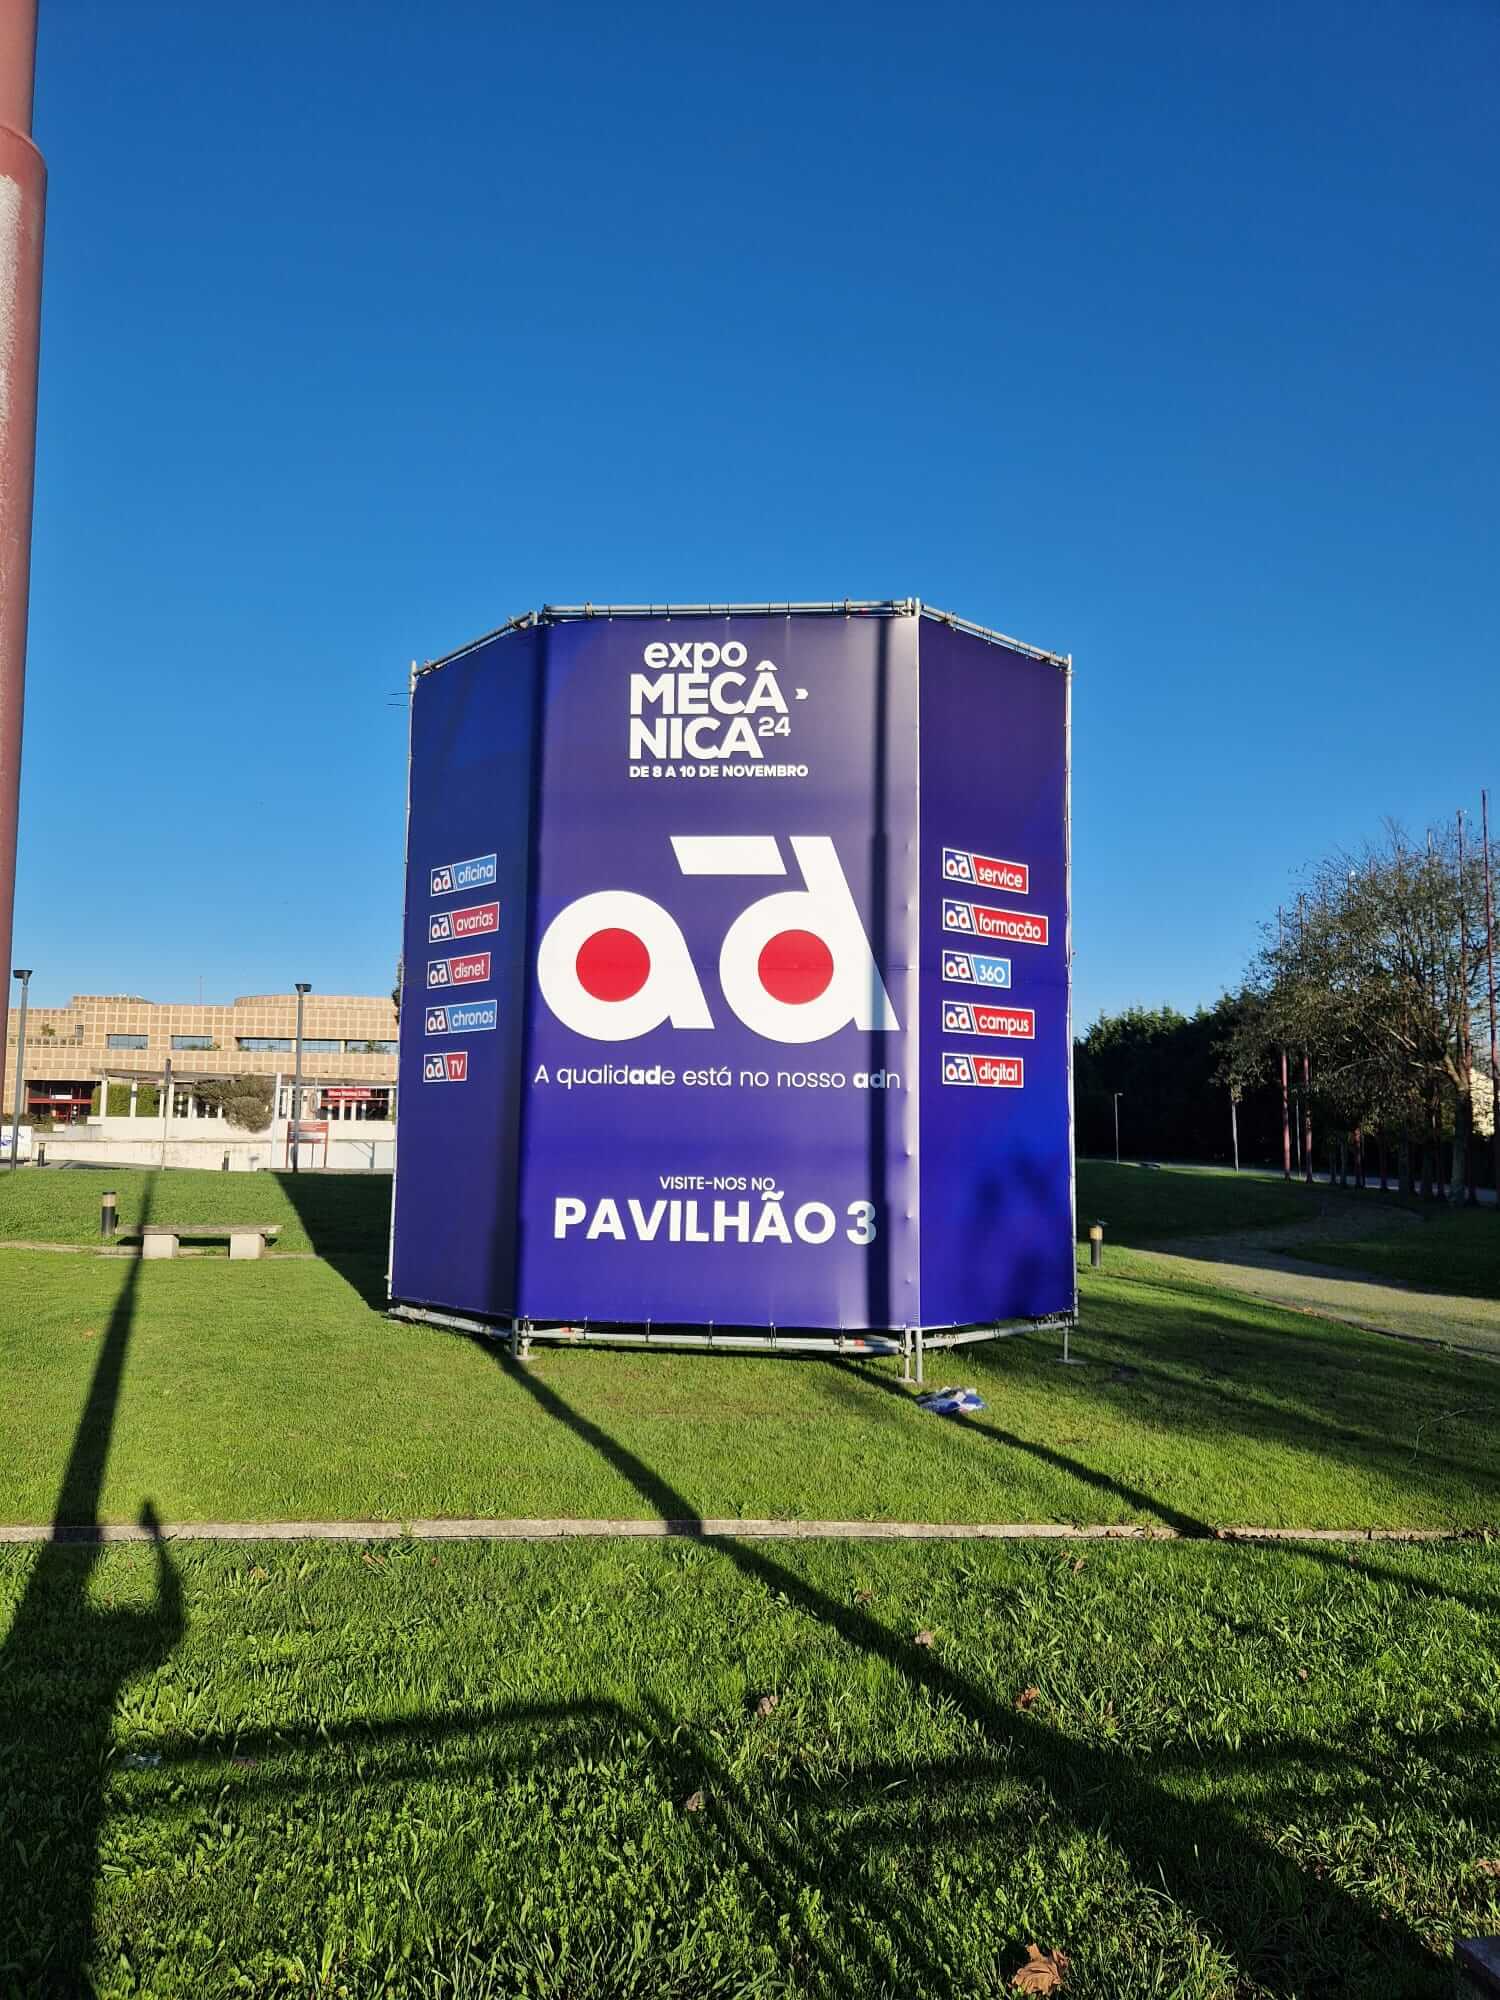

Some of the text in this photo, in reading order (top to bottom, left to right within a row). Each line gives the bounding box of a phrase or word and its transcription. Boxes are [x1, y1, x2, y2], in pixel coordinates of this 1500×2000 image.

[643, 641, 748, 676] expo
[629, 716, 791, 759] NICA 24
[629, 765, 808, 778] DE 8 A 10 DE NOVEMBRO
[458, 864, 493, 884] oficina
[979, 868, 1023, 887] service
[457, 912, 494, 931] avarias
[979, 913, 1041, 940] formação
[454, 962, 485, 979] disnet
[980, 965, 1005, 983] 360
[452, 1011, 494, 1027] chronos
[979, 1014, 1029, 1035] campus
[451, 1059, 464, 1075] TV
[979, 1061, 1018, 1085] digital
[534, 1065, 900, 1090] A qualidade está no nosso adn
[659, 1176, 775, 1191] VISITE-NOS NO
[554, 1191, 877, 1245] PAVILHÃO 3
